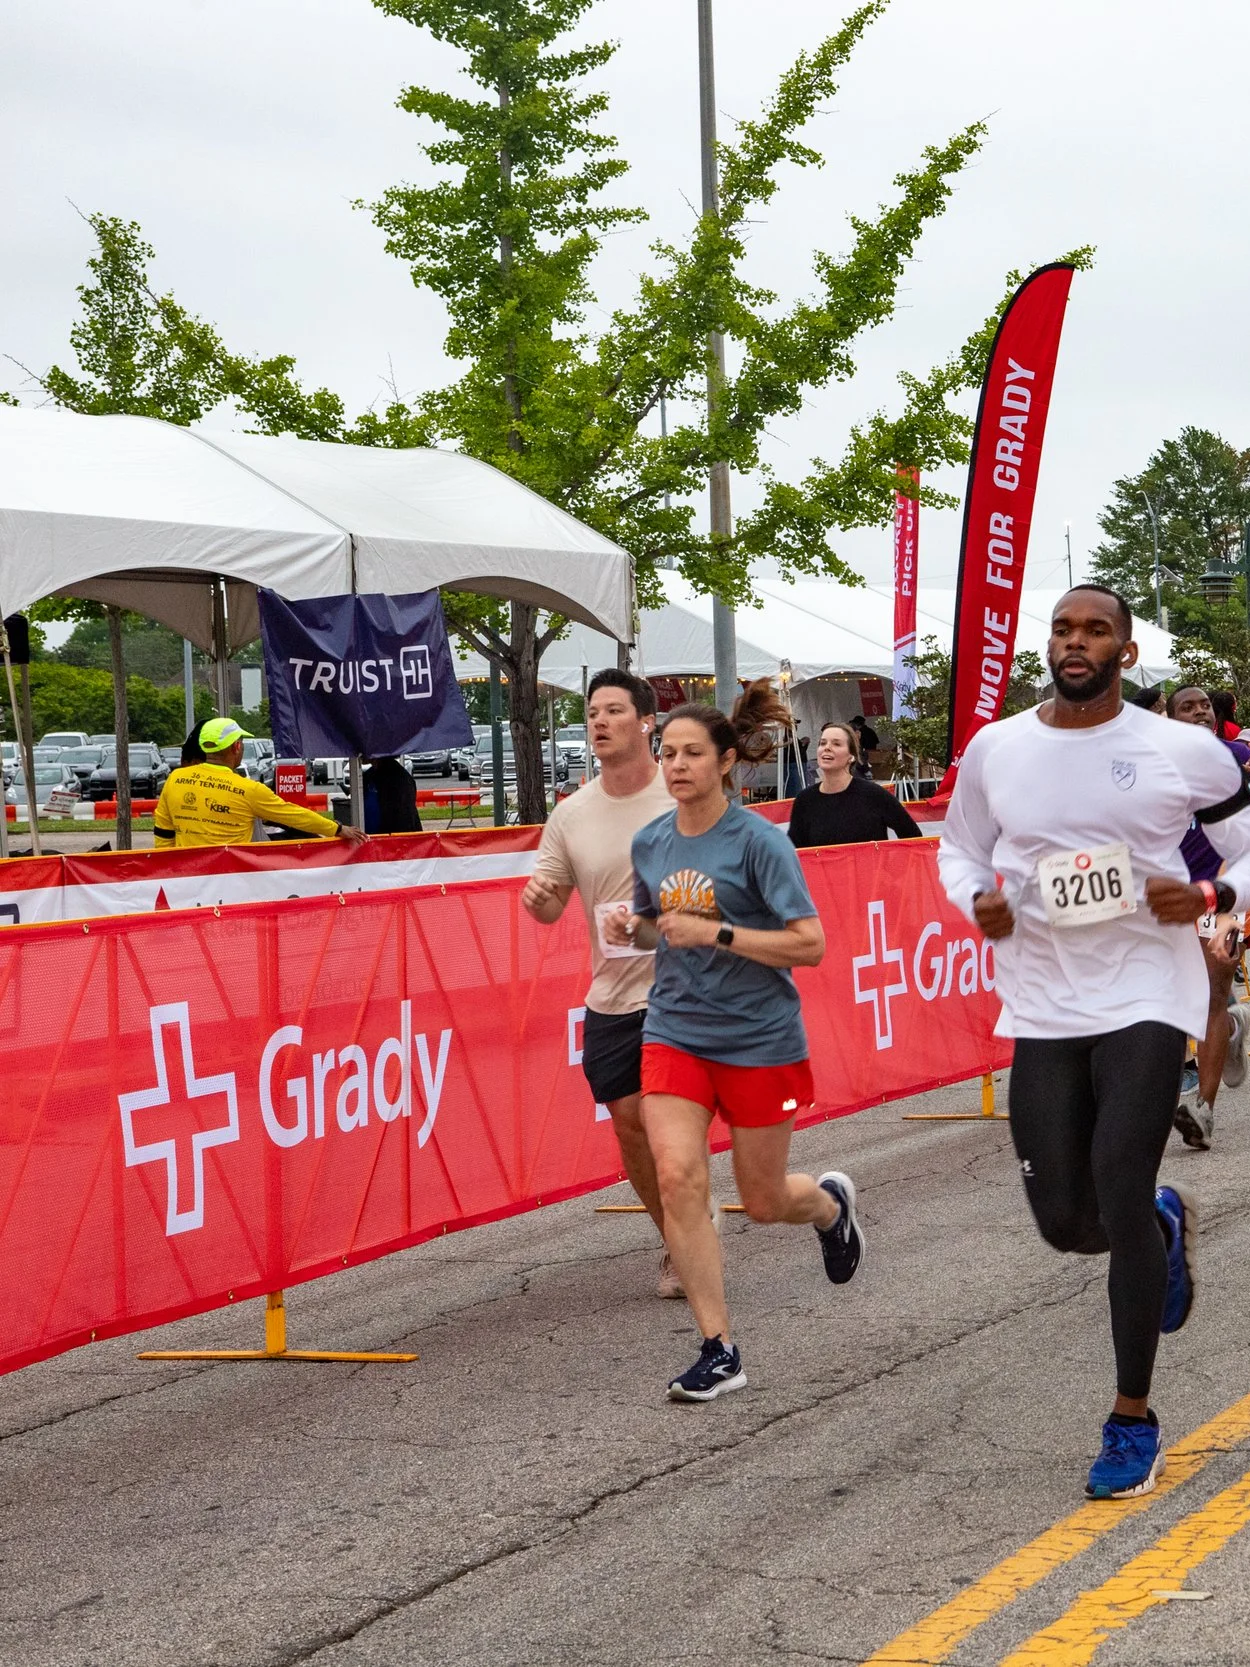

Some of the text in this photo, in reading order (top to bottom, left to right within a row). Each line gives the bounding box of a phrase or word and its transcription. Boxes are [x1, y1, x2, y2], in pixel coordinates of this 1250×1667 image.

[973, 357, 1036, 721] MOVE FOR GRADY
[901, 539, 914, 597] PICK
[289, 657, 394, 695] TRUIST
[175, 778, 246, 796] ARMY TEN-MILER
[279, 775, 303, 784] PACKET
[279, 785, 305, 793] PICK-UP
[210, 803, 231, 814] KBR
[1052, 867, 1123, 908] 3206
[913, 921, 998, 1001] Gra
[259, 1000, 452, 1148] Grady
